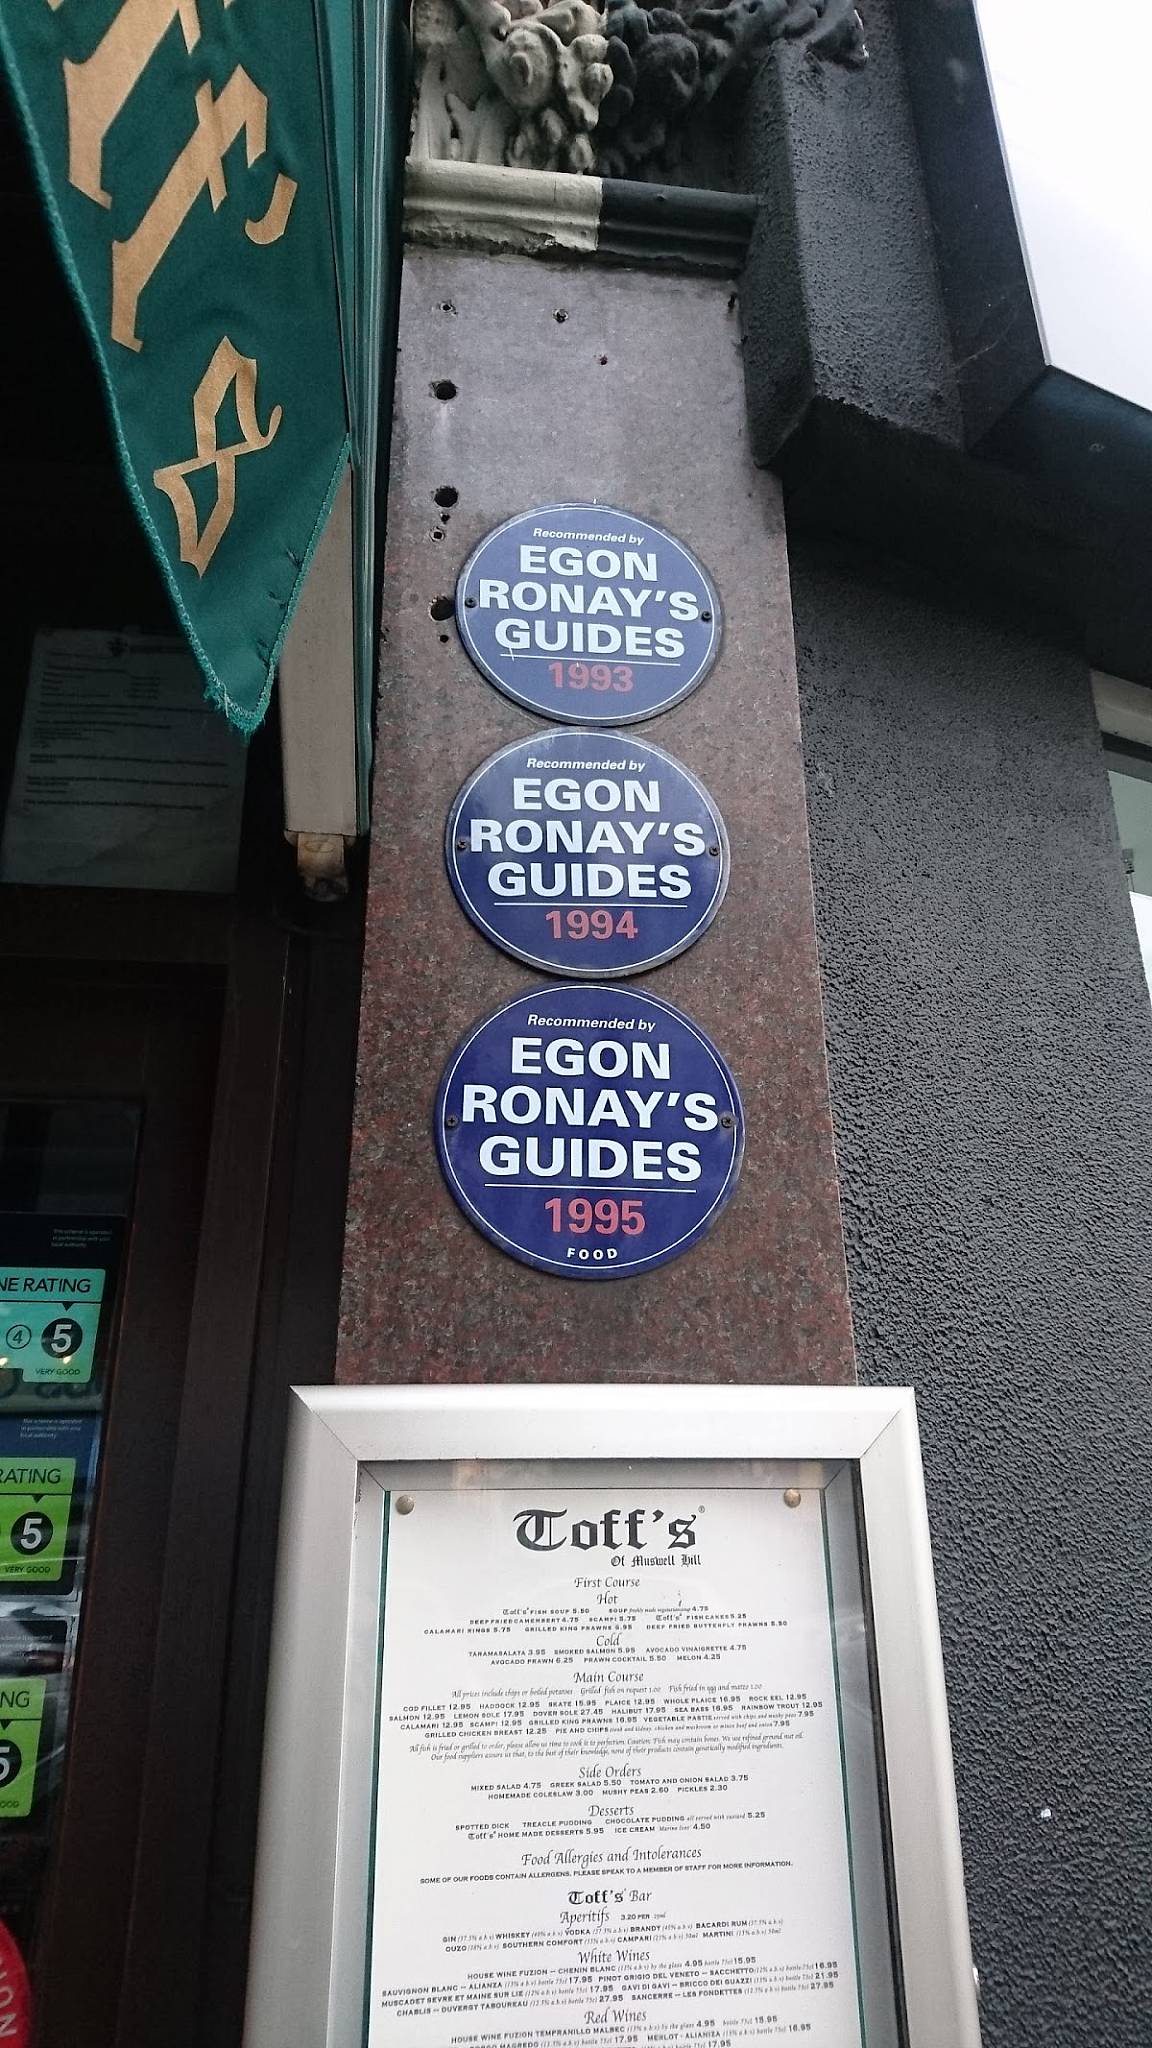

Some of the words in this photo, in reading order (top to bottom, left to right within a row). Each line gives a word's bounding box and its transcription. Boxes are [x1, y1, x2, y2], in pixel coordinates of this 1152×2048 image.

[533, 528, 626, 543] Recommended
[629, 534, 645, 545] by
[520, 544, 658, 581] EGON
[479, 579, 699, 621] RONAY'S
[494, 618, 685, 659] GUIDES
[548, 662, 634, 692] 1993
[527, 758, 625, 771] Recommended
[629, 760, 645, 772] by
[514, 778, 661, 813] EGON
[471, 819, 706, 857] RONAY'S
[488, 862, 692, 899] GUIDES
[545, 910, 638, 940] 1994
[527, 1014, 635, 1030] Recommended
[638, 1020, 655, 1032] by
[511, 1037, 670, 1080] EGON
[462, 1084, 719, 1131] RONAY'S
[479, 1135, 702, 1182] GUIDES
[544, 1198, 646, 1235] 1995
[567, 1247, 618, 1260] FOOD
[23, 1278, 91, 1293] RATING
[50, 1324, 73, 1353] 5
[35, 1367, 54, 1375] VERY
[56, 1368, 81, 1376] GOOD
[20, 1518, 42, 1550] 5
[611, 1555, 625, 1567] Of
[631, 1554, 675, 1567] Muswell
[681, 1554, 702, 1566] Hill
[26, 1566, 51, 1574] GOOD
[574, 1576, 601, 1588] First
[605, 1577, 641, 1587] Course
[597, 1591, 618, 1605] Hot
[596, 1632, 623, 1647] Cold
[573, 1672, 603, 1683] Main
[605, 1672, 644, 1682] Course
[425, 1731, 456, 1739] GRILLED
[578, 1764, 601, 1779] Side
[605, 1762, 642, 1778] Orders
[488, 1792, 531, 1800] HOMEMADE
[709, 1784, 728, 1792] 2.30
[588, 1805, 634, 1817] Desserts
[521, 1849, 553, 1867] Food
[554, 1849, 603, 1870] Allergies
[607, 1846, 631, 1862] and
[633, 1845, 702, 1861] Intolerances
[573, 1869, 600, 1877] PLEASE
[628, 1889, 652, 1902] Bar
[560, 1906, 610, 1929] Aperitifs
[495, 1932, 530, 1940] WHISKEY
[564, 1928, 591, 1936] VODKA
[630, 1925, 661, 1933] BRANDY
[695, 1921, 729, 1929] BACARDI
[502, 1941, 544, 1949] SOUTHERN
[617, 1935, 652, 1943] CAMPARI
[578, 1948, 612, 1964] White
[616, 1949, 650, 1962] Wines
[584, 2007, 610, 2025] Red
[612, 2010, 647, 2023] Wines
